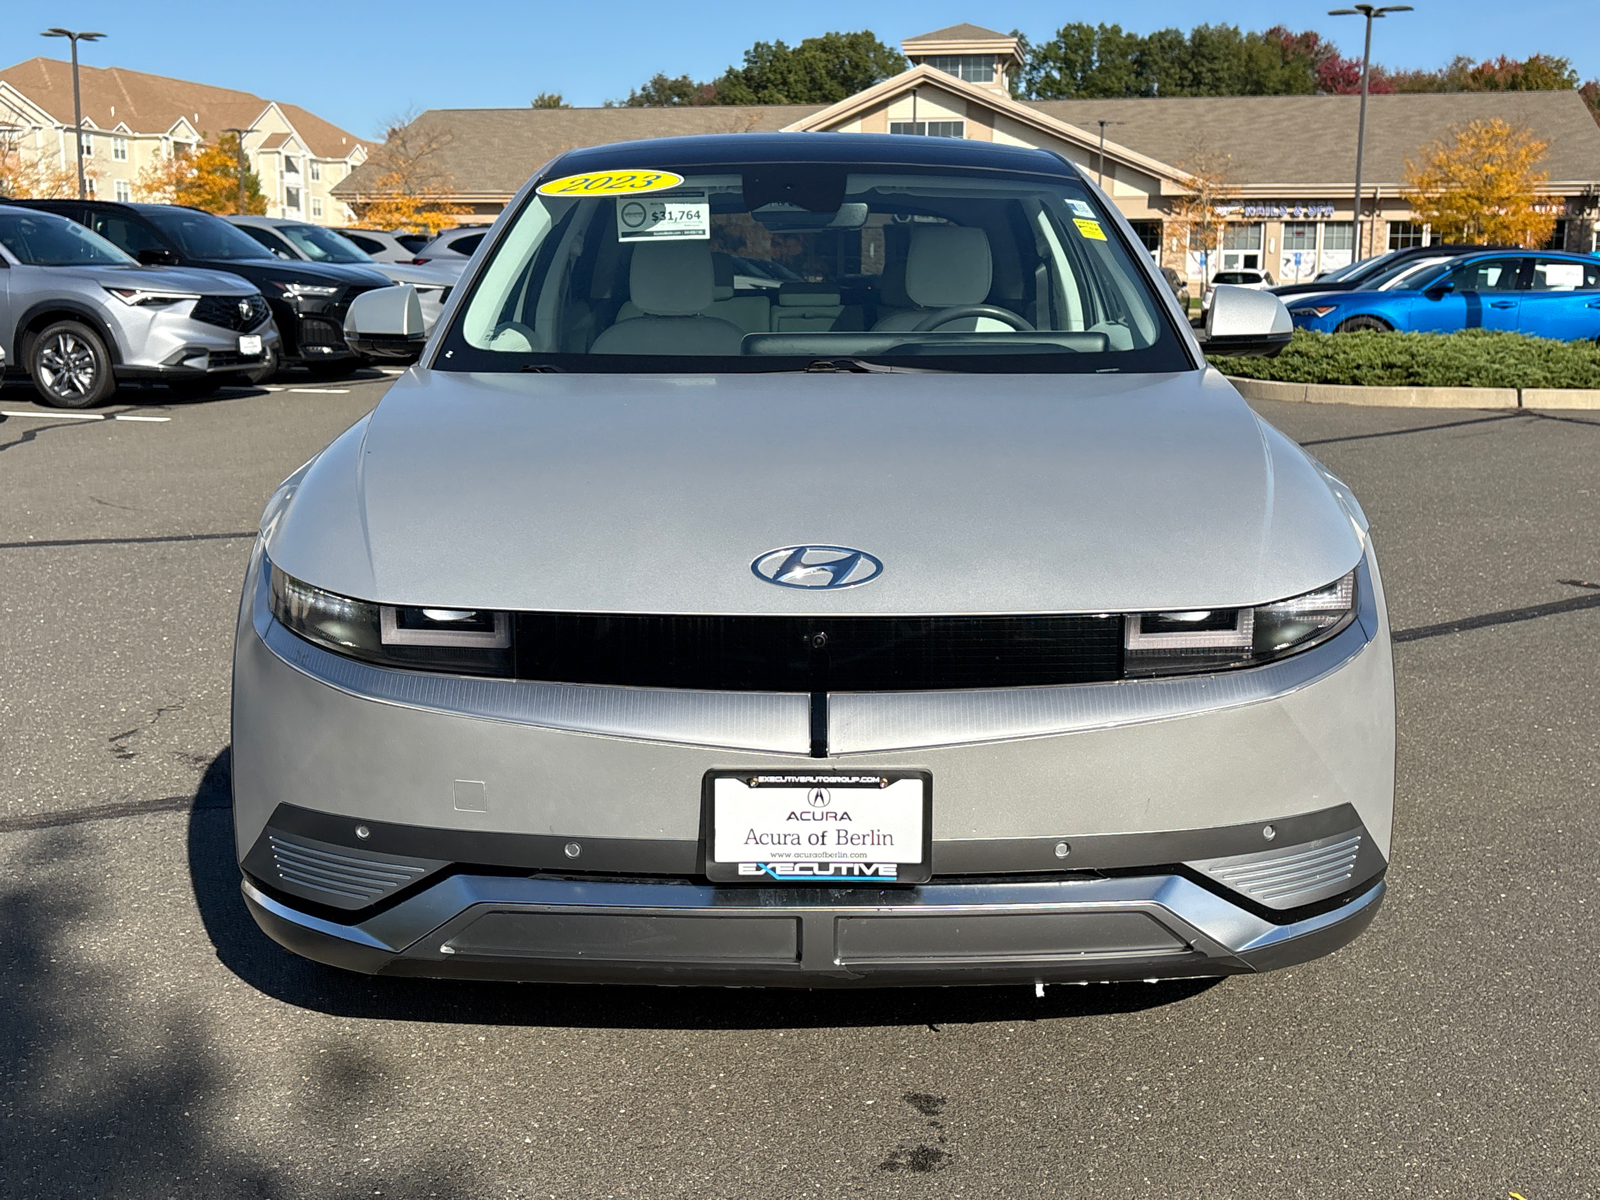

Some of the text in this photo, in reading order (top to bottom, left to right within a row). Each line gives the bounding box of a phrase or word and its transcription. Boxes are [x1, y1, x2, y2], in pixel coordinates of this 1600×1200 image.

[558, 174, 662, 193] 2023
[651, 210, 702, 223] $31,764
[1244, 202, 1287, 217] NAILS
[1293, 202, 1303, 217] &
[1307, 202, 1335, 217] SPA
[757, 775, 880, 783] EXECUTIVEAUTOGROUP.COM
[785, 811, 853, 822] ACURA
[743, 828, 894, 846] Acura of Berlin
[770, 851, 868, 859] www.acuraofberlin.com
[738, 862, 898, 877] EXECUTIVE
